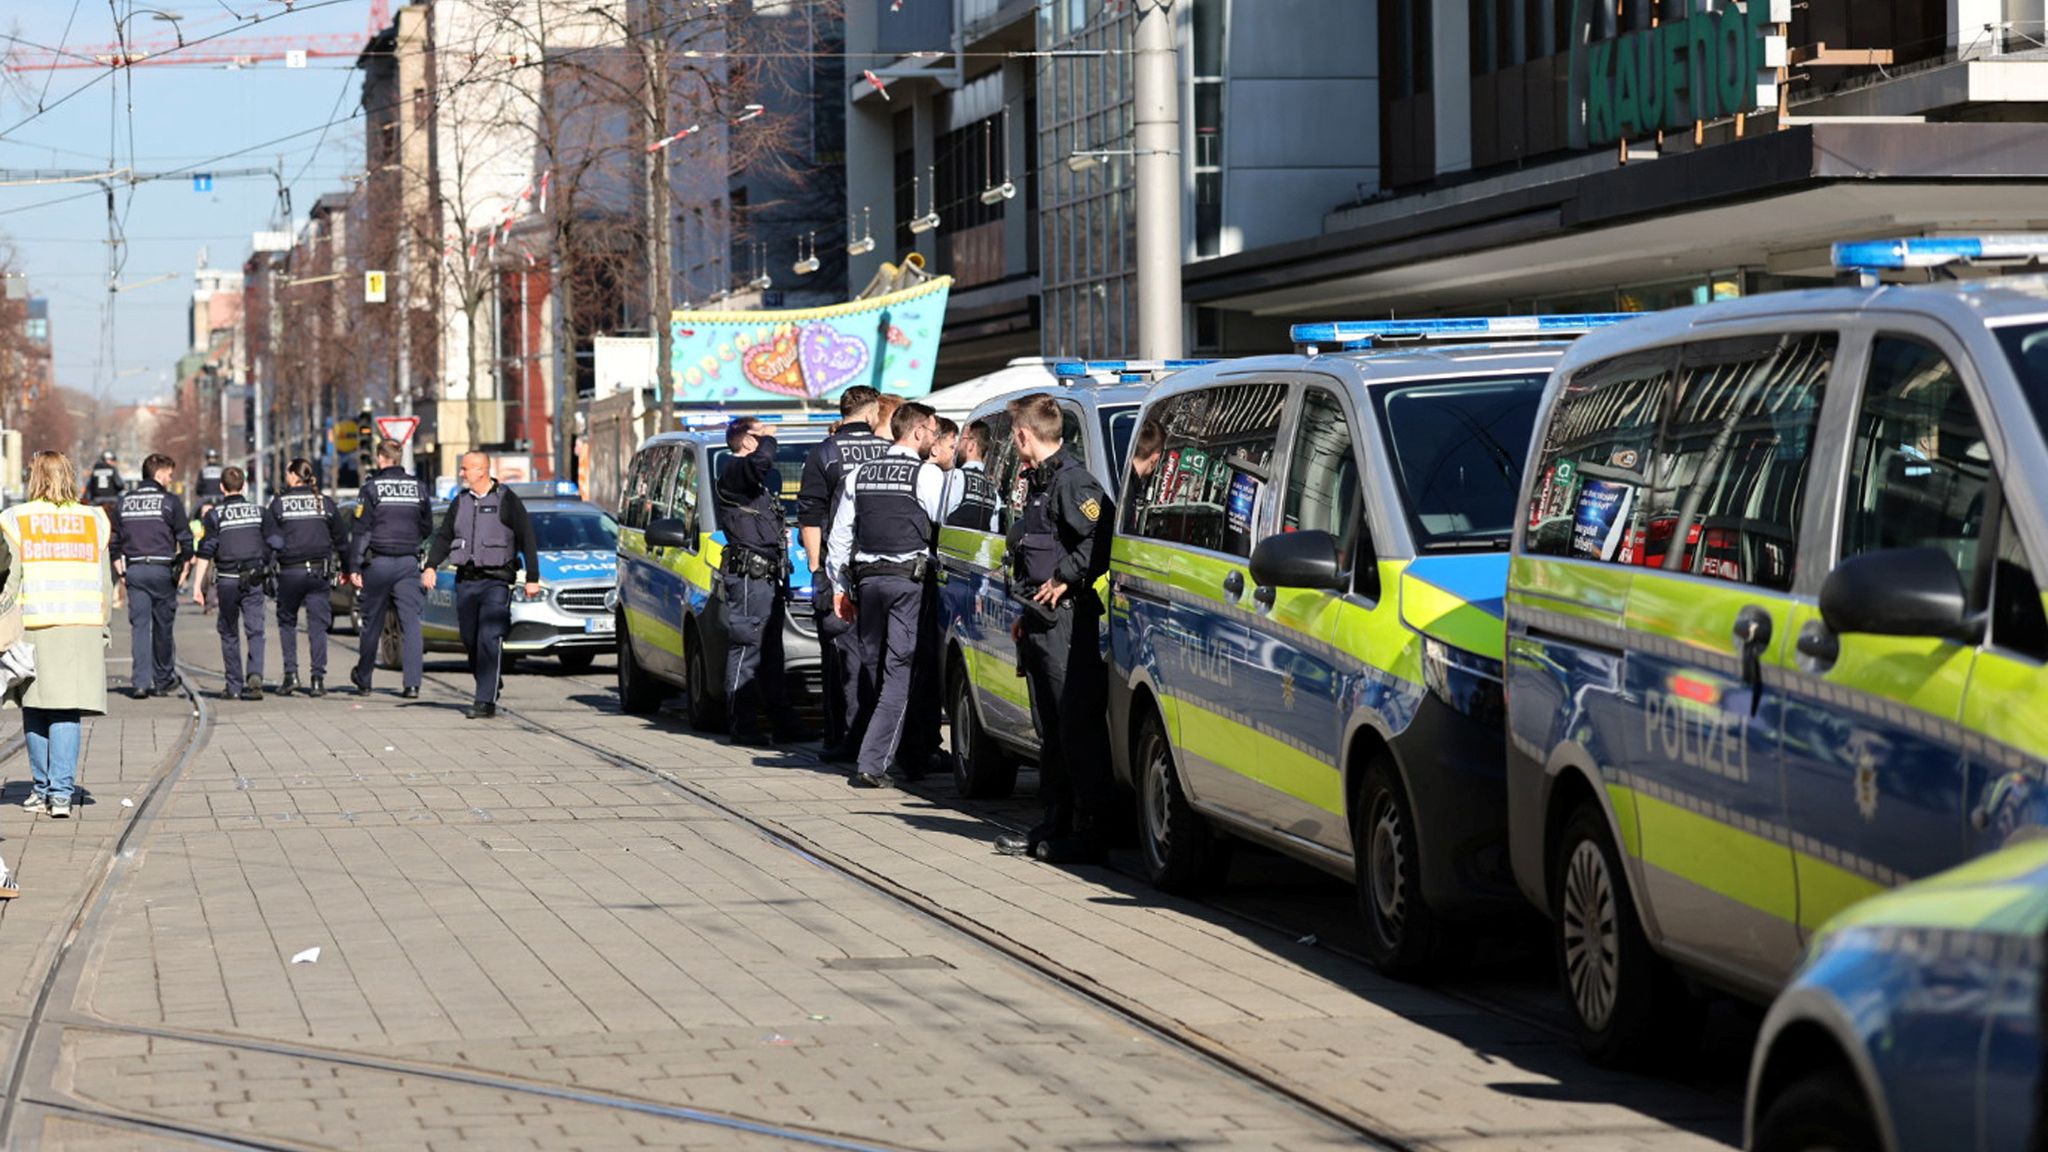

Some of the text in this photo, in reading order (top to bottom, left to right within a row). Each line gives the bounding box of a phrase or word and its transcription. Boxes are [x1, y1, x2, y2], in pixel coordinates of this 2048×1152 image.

[858, 464, 914, 482] POLIZEI
[377, 483, 419, 497] POLIZEI
[122, 499, 162, 511] POLIZEI
[30, 514, 86, 535] POLIZEI
[23, 539, 94, 560] Betreuung
[1180, 633, 1232, 688] POLIZEI
[1646, 688, 1749, 783] POLIZEI
